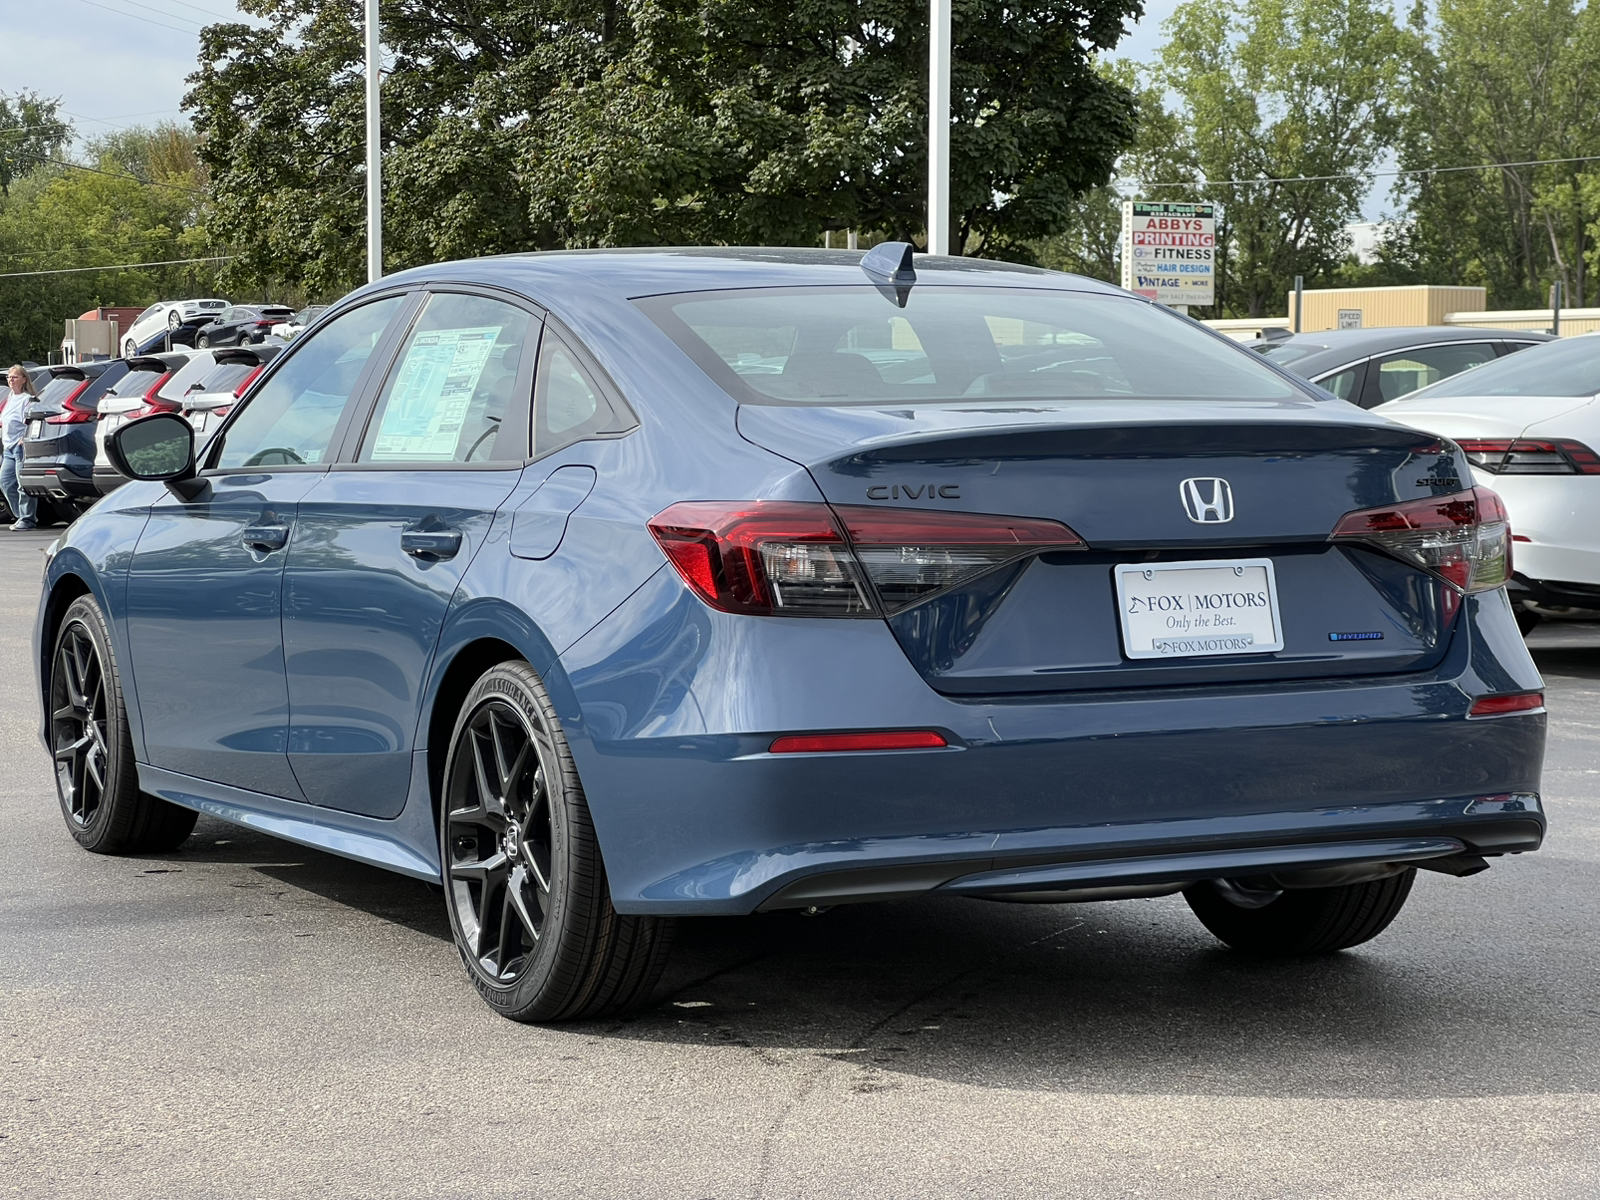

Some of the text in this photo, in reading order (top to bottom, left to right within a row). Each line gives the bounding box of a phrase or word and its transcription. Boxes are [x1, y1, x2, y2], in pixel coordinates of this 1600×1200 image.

[1147, 218, 1203, 230] ABBYS
[1134, 232, 1212, 246] PRINTING
[1154, 248, 1211, 259] FITNESS
[1157, 263, 1210, 273] HAIR DESIGN
[1136, 276, 1180, 287] VINTAGE
[1340, 312, 1361, 320] SPEED
[1341, 320, 1358, 329] LIMIT
[1415, 477, 1459, 487] SPORT
[866, 484, 961, 501] CIVIC
[1147, 591, 1267, 611] FOX MOTORS
[1166, 612, 1237, 632] Only the Best.
[1338, 632, 1382, 640] HYBRID
[1171, 637, 1247, 654] FOX MOTORS
[489, 678, 538, 724] ASSURANCE
